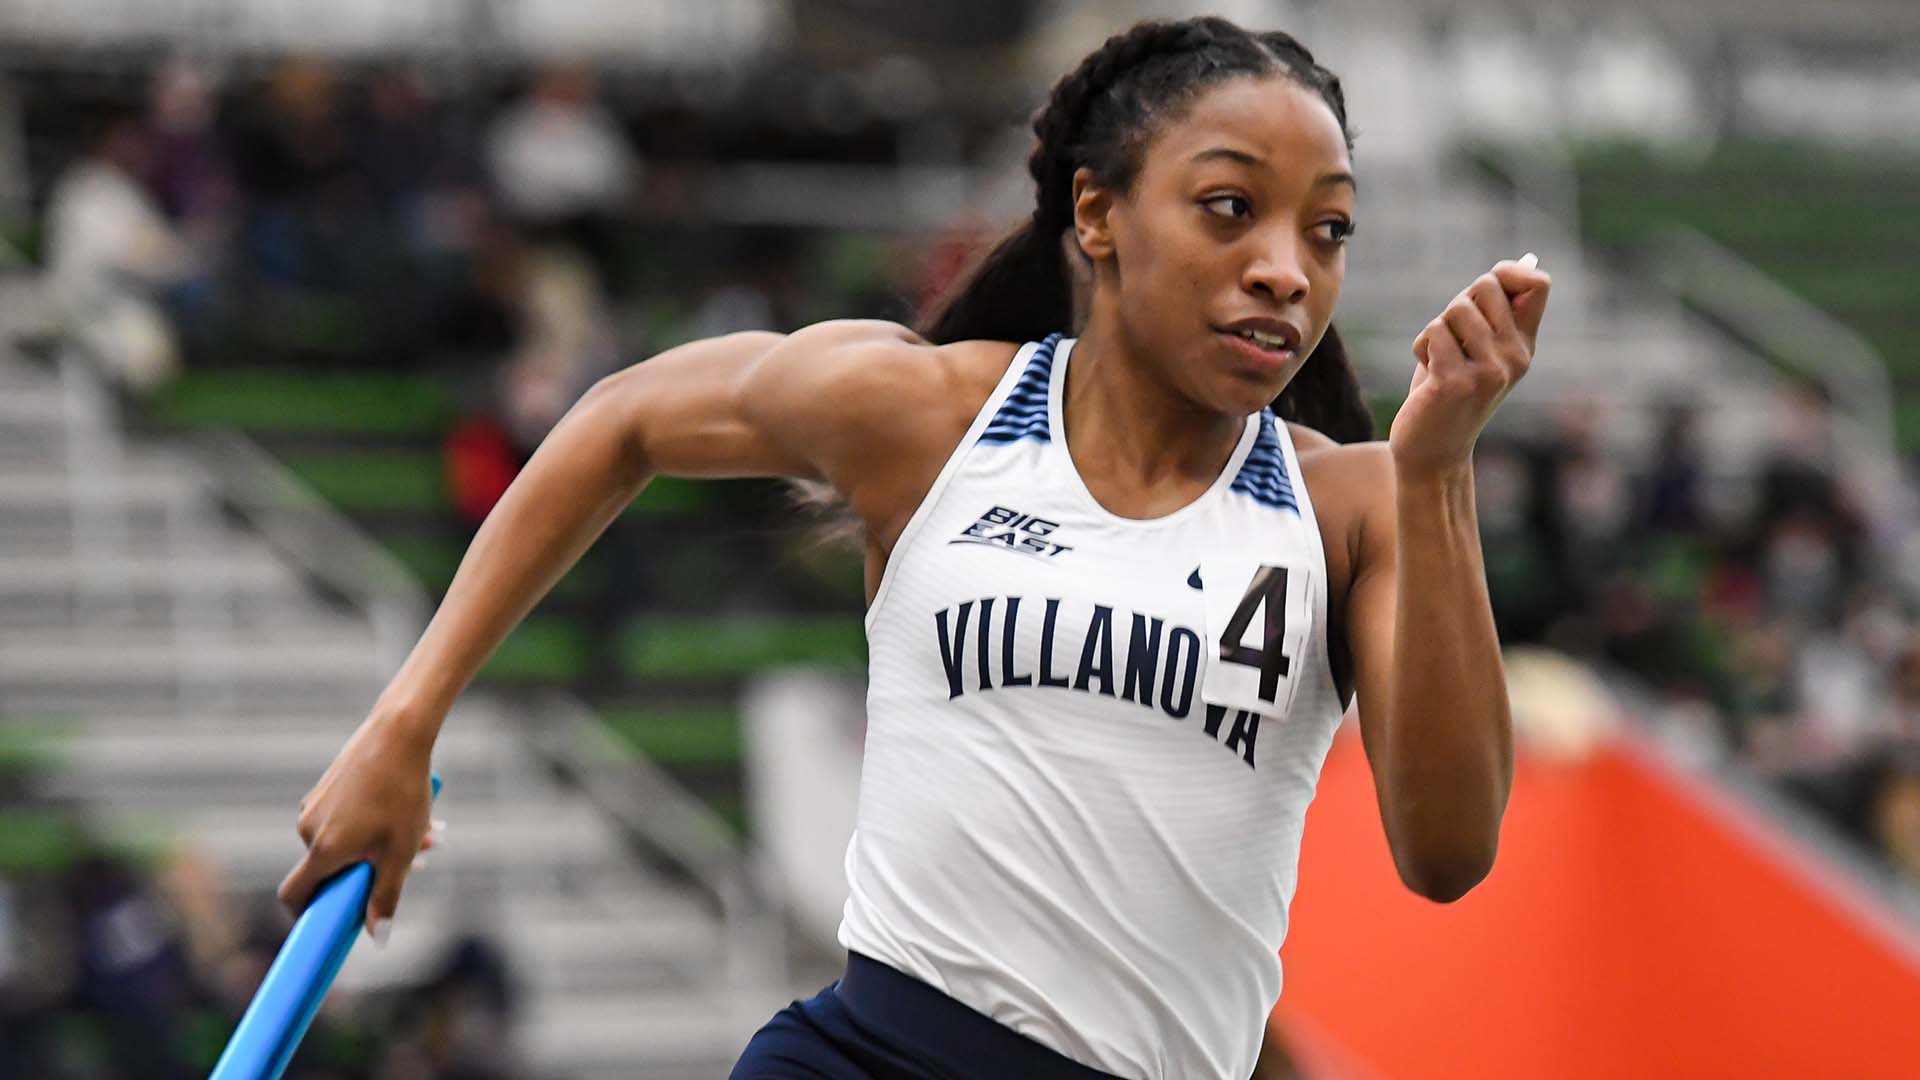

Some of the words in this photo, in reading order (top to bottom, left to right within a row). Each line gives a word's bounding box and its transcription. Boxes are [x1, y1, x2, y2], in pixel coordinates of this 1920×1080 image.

[979, 505, 1061, 537] BIG
[960, 523, 1074, 557] EAST
[1219, 564, 1290, 705] 4
